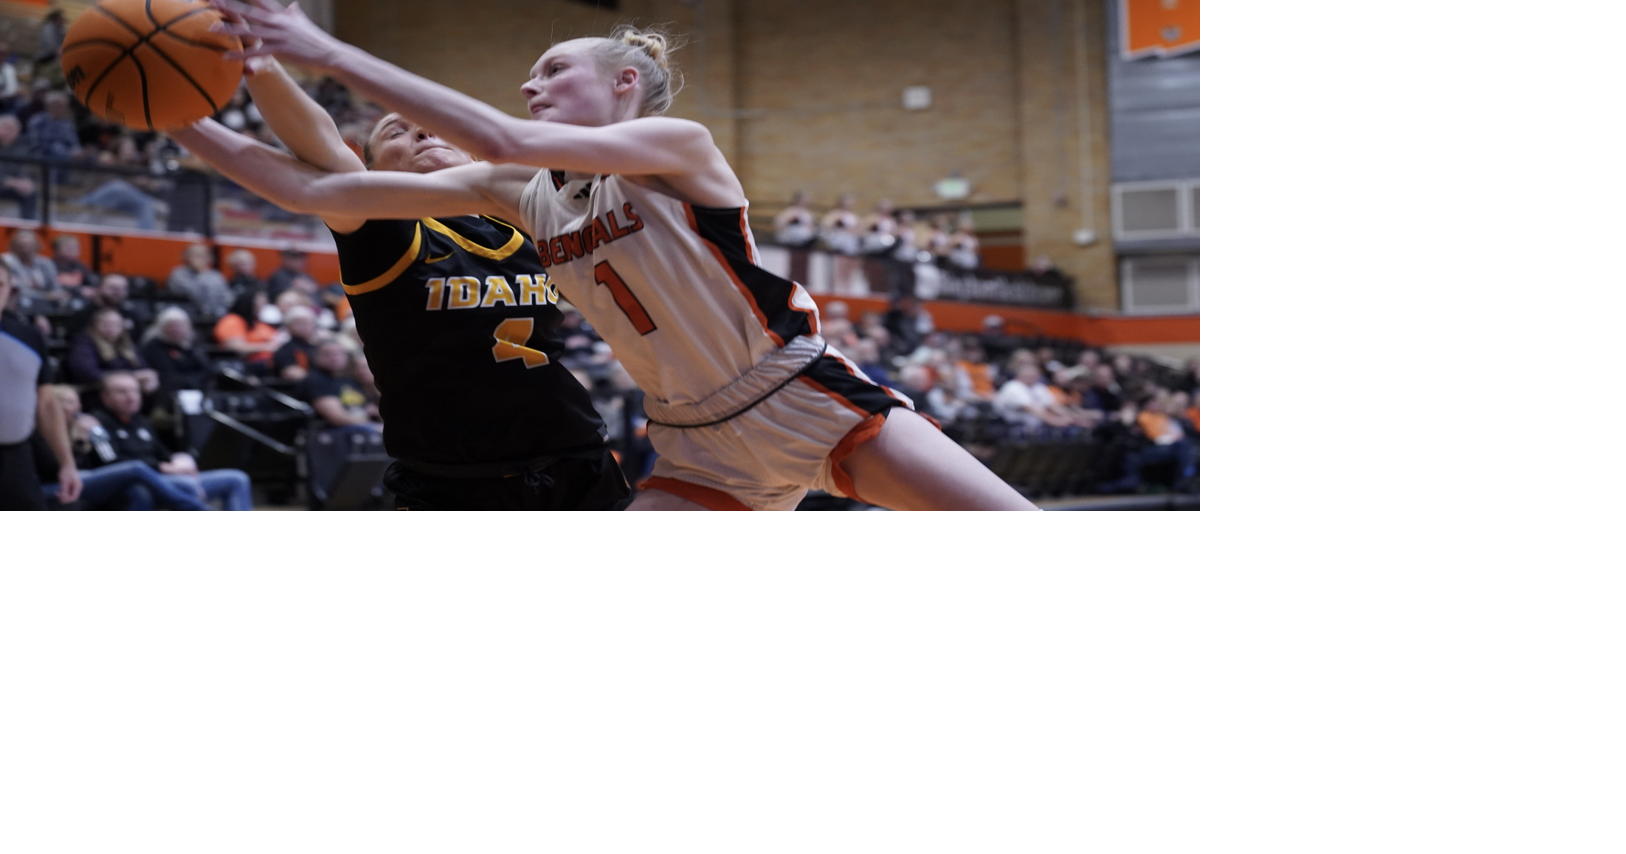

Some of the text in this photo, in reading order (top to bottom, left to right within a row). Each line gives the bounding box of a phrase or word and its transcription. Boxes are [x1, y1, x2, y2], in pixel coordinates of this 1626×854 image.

[537, 202, 644, 268] BENGALS
[594, 260, 657, 336] 1
[492, 317, 550, 369] 4
